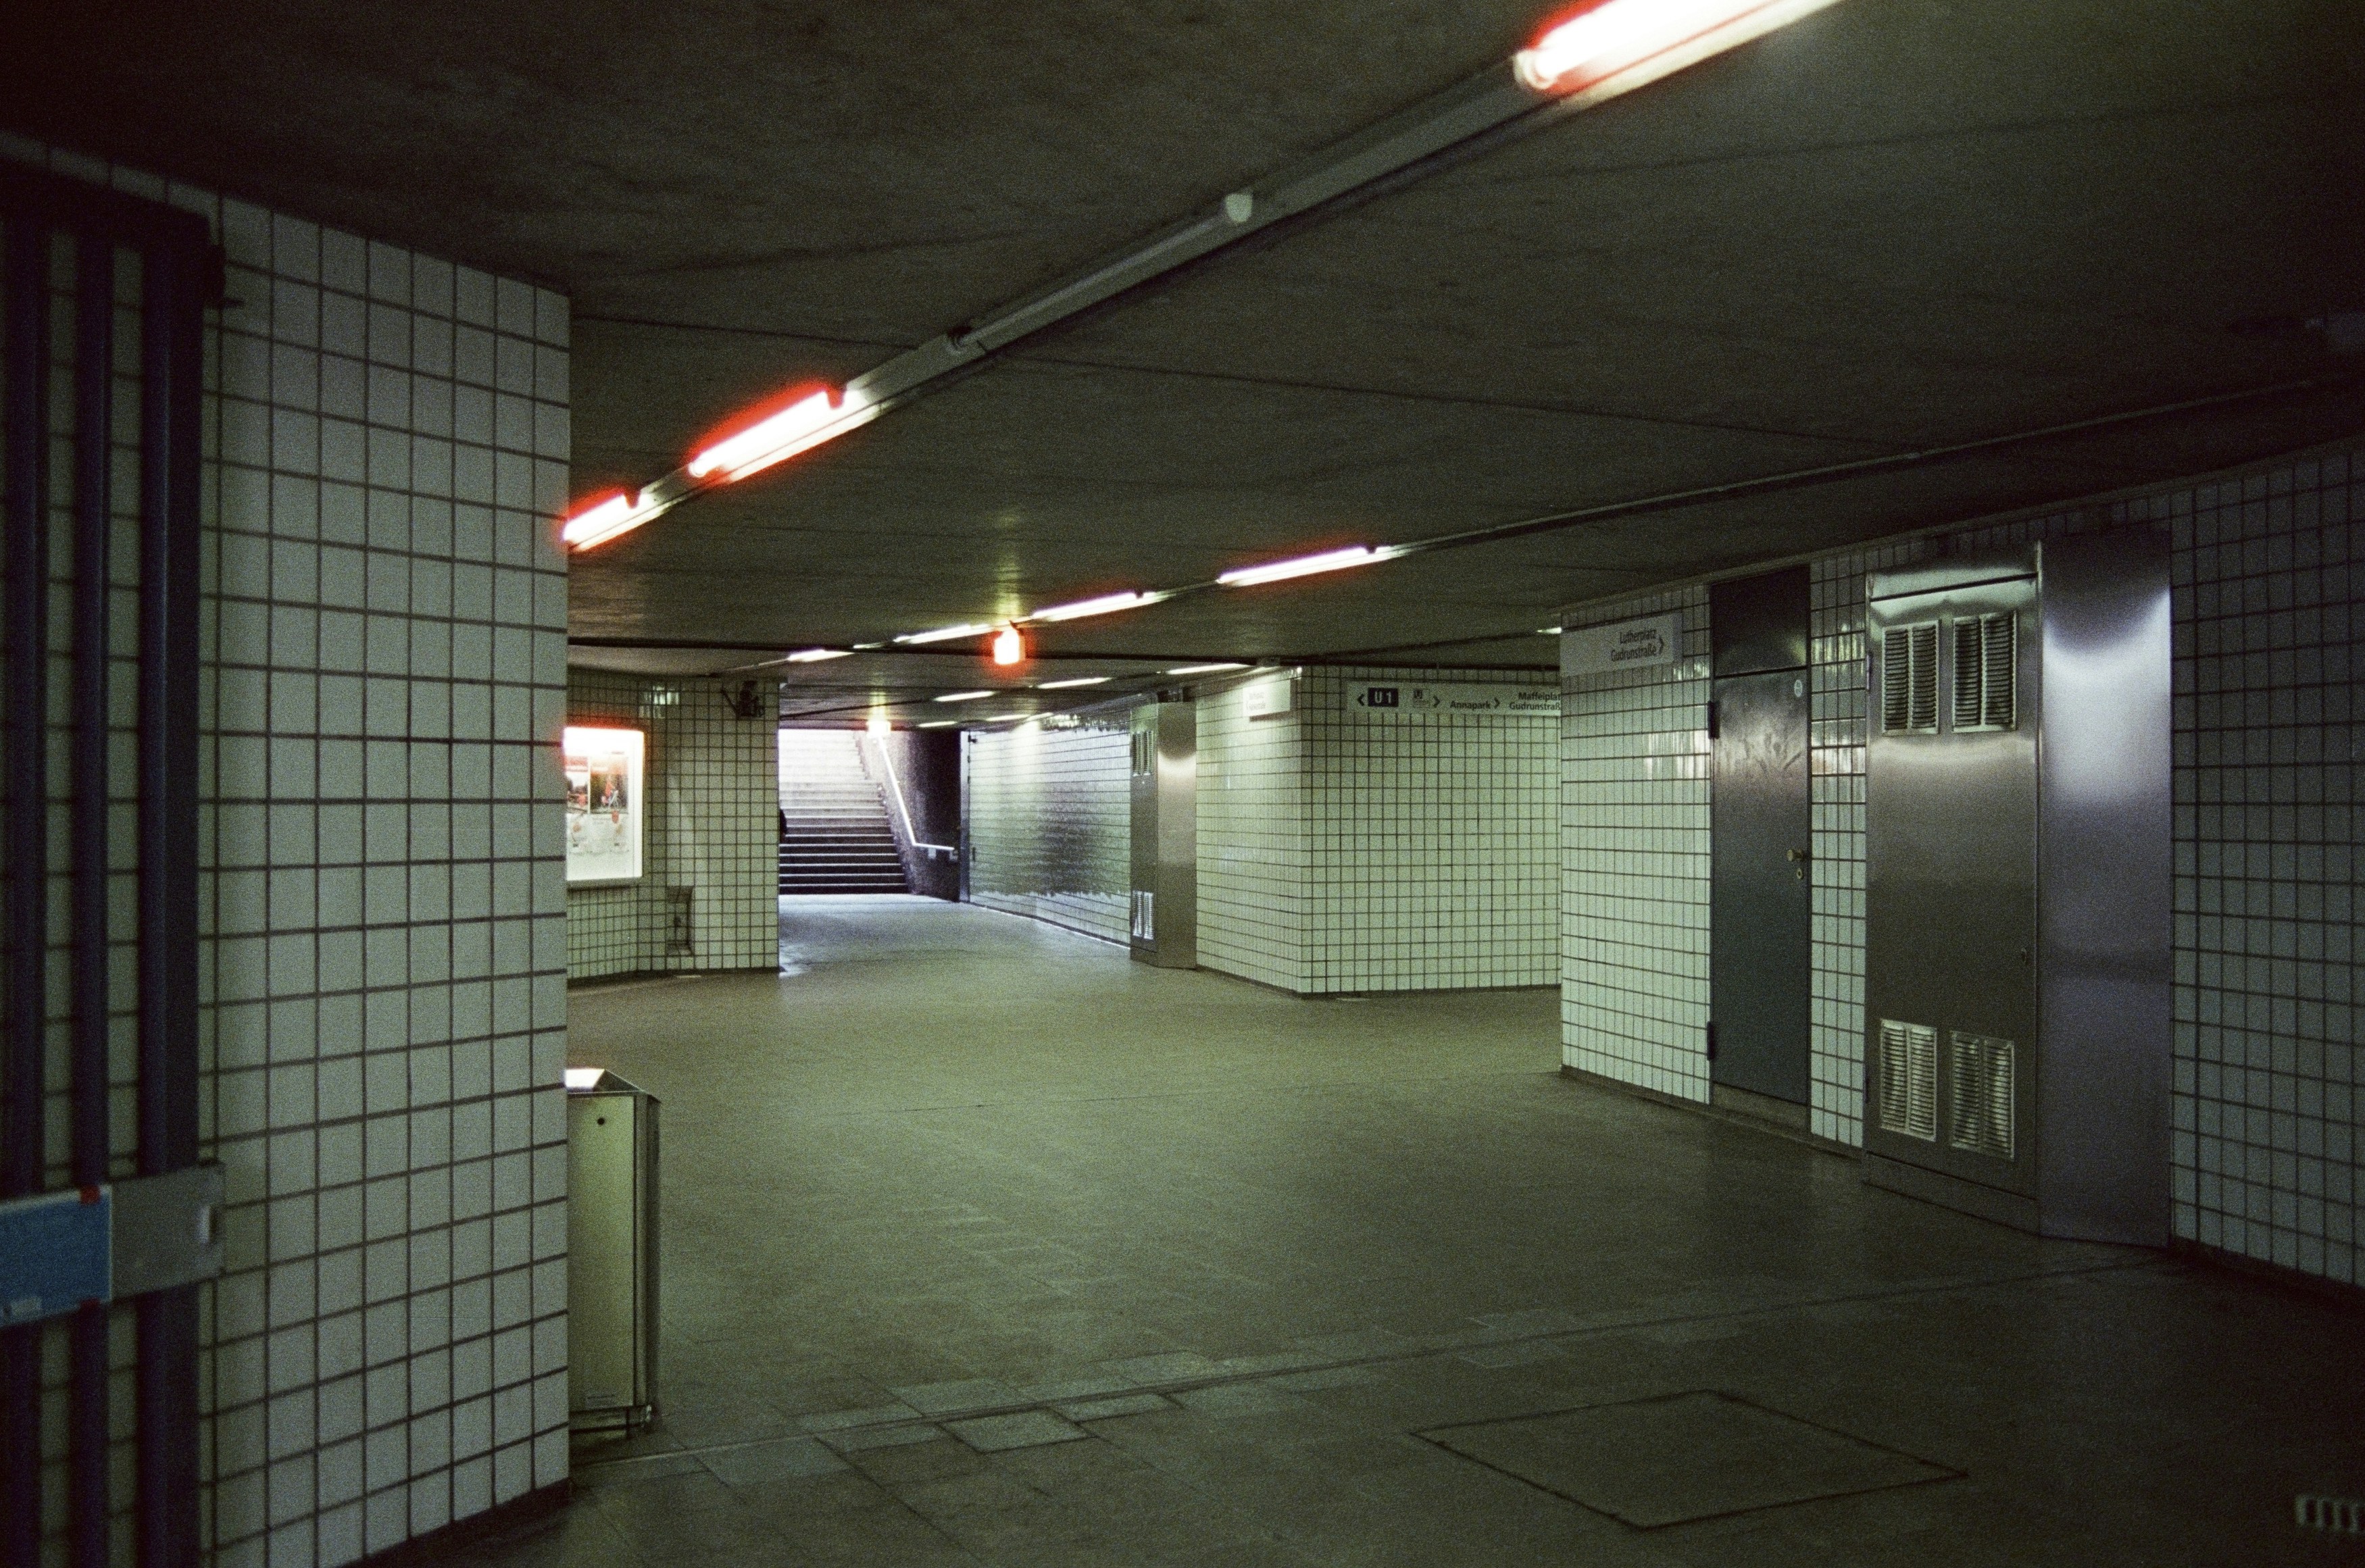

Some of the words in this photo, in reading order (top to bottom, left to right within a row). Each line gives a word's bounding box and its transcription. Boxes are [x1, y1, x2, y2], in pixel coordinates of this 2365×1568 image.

[1619, 627, 1657, 644] Lutherplatz
[1610, 642, 1657, 662] Gudrunstraße
[1449, 701, 1491, 710] Annapark
